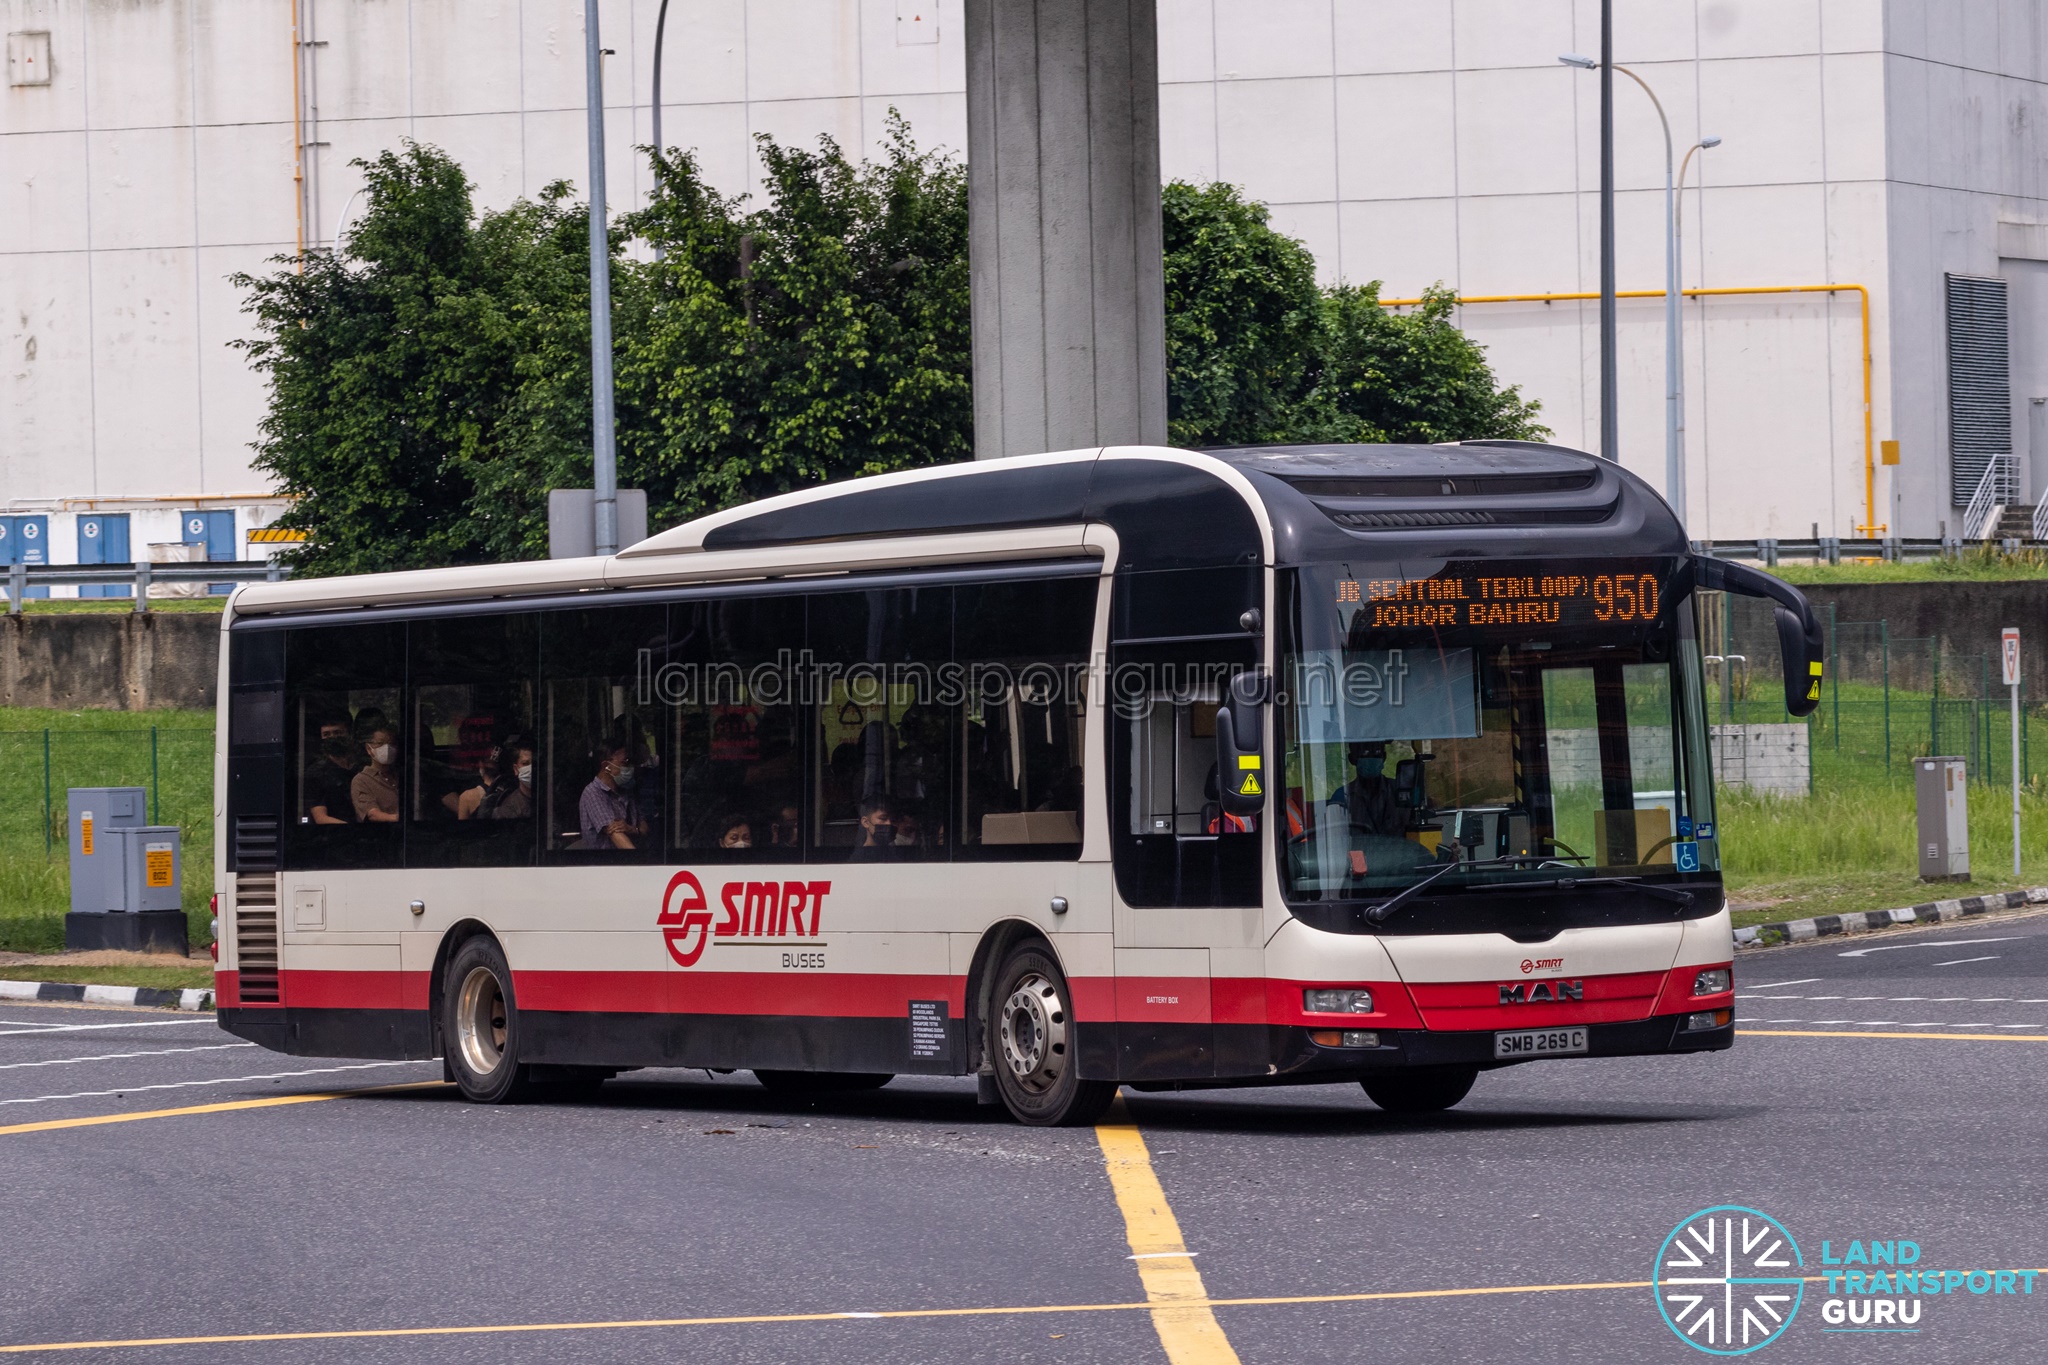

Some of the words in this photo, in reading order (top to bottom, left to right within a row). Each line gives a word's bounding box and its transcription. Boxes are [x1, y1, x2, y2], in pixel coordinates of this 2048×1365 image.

[1336, 581, 1360, 603] JB
[1368, 578, 1470, 602] SENTRAL
[1477, 575, 1588, 599] TER(LOOP)
[1593, 574, 1659, 621] 950
[1372, 604, 1457, 627] JOHOR
[1469, 602, 1560, 625] BAHRU
[714, 881, 832, 937] SMRT
[782, 953, 825, 968] BUSES
[1535, 958, 1564, 969] SMRT
[1146, 996, 1168, 1004] BATTERY
[1168, 996, 1179, 1004] BOX
[1498, 980, 1583, 1004] MAN
[1501, 1035, 1533, 1053] SMB
[1537, 1032, 1568, 1050] 269
[1572, 1031, 1582, 1047] C
